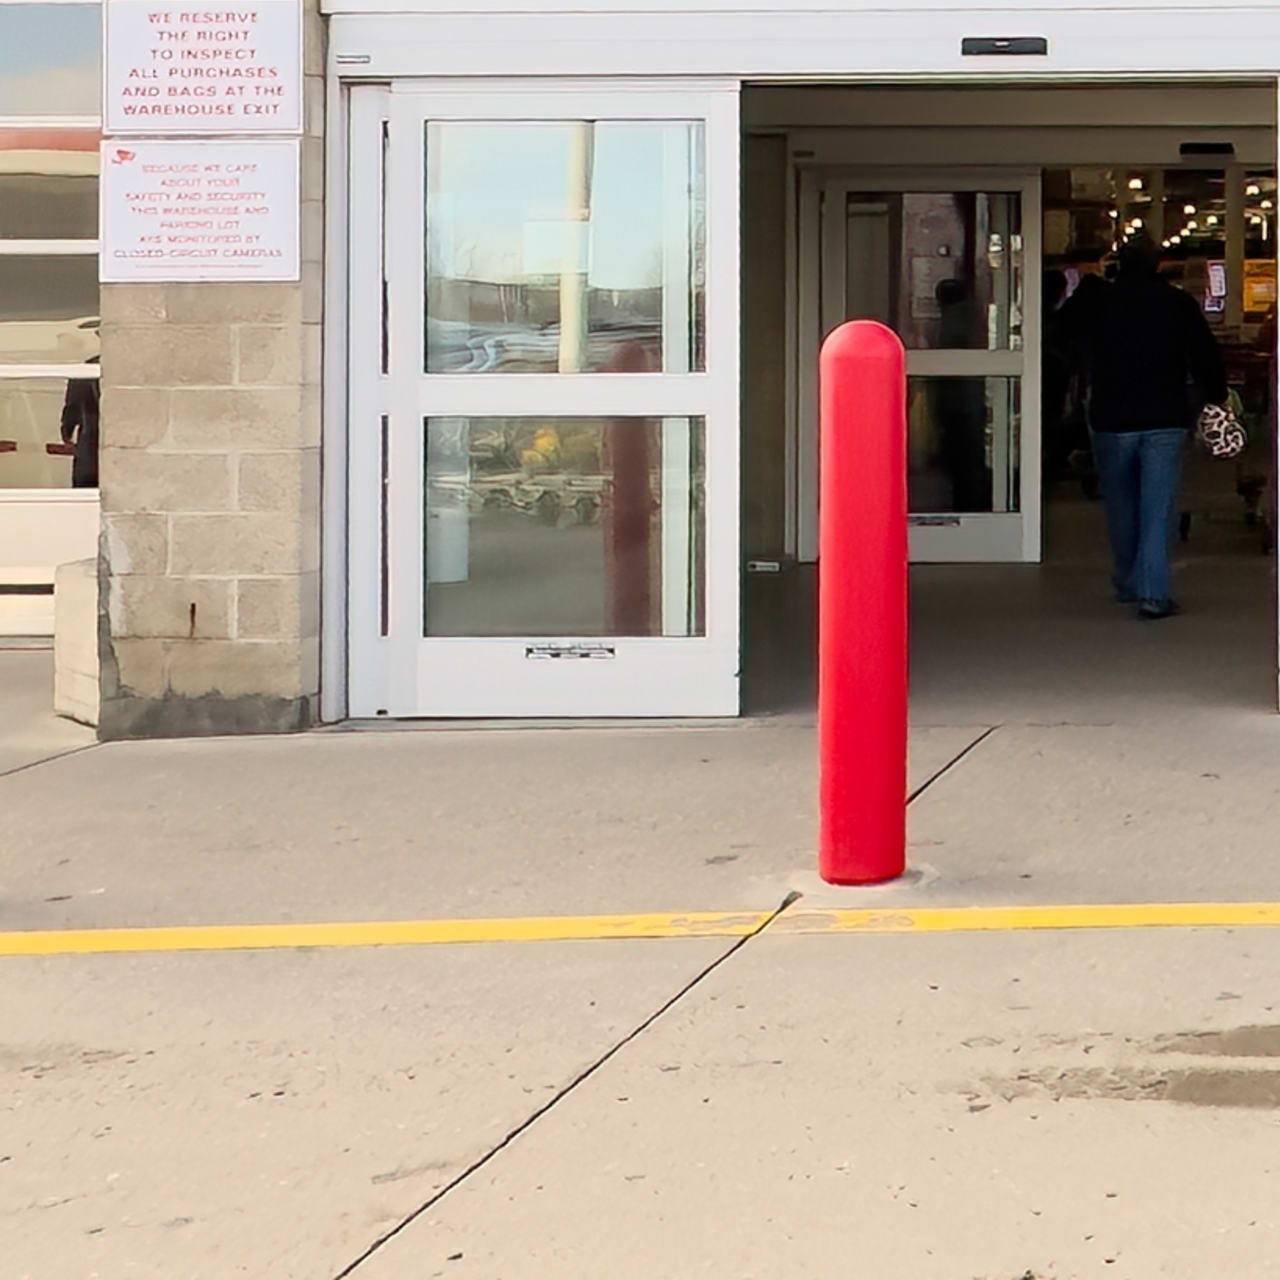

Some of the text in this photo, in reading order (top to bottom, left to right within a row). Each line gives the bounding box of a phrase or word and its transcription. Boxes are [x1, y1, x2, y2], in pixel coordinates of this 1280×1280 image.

[148, 13, 258, 24] WE RESERVE
[158, 31, 249, 41] THE RIGHT
[151, 49, 257, 60] TO INSPECT
[128, 68, 278, 78] ALL PURCHASES
[122, 87, 285, 97] AND BAGS AT THE
[123, 105, 280, 116] WAREHOUSE EXIT
